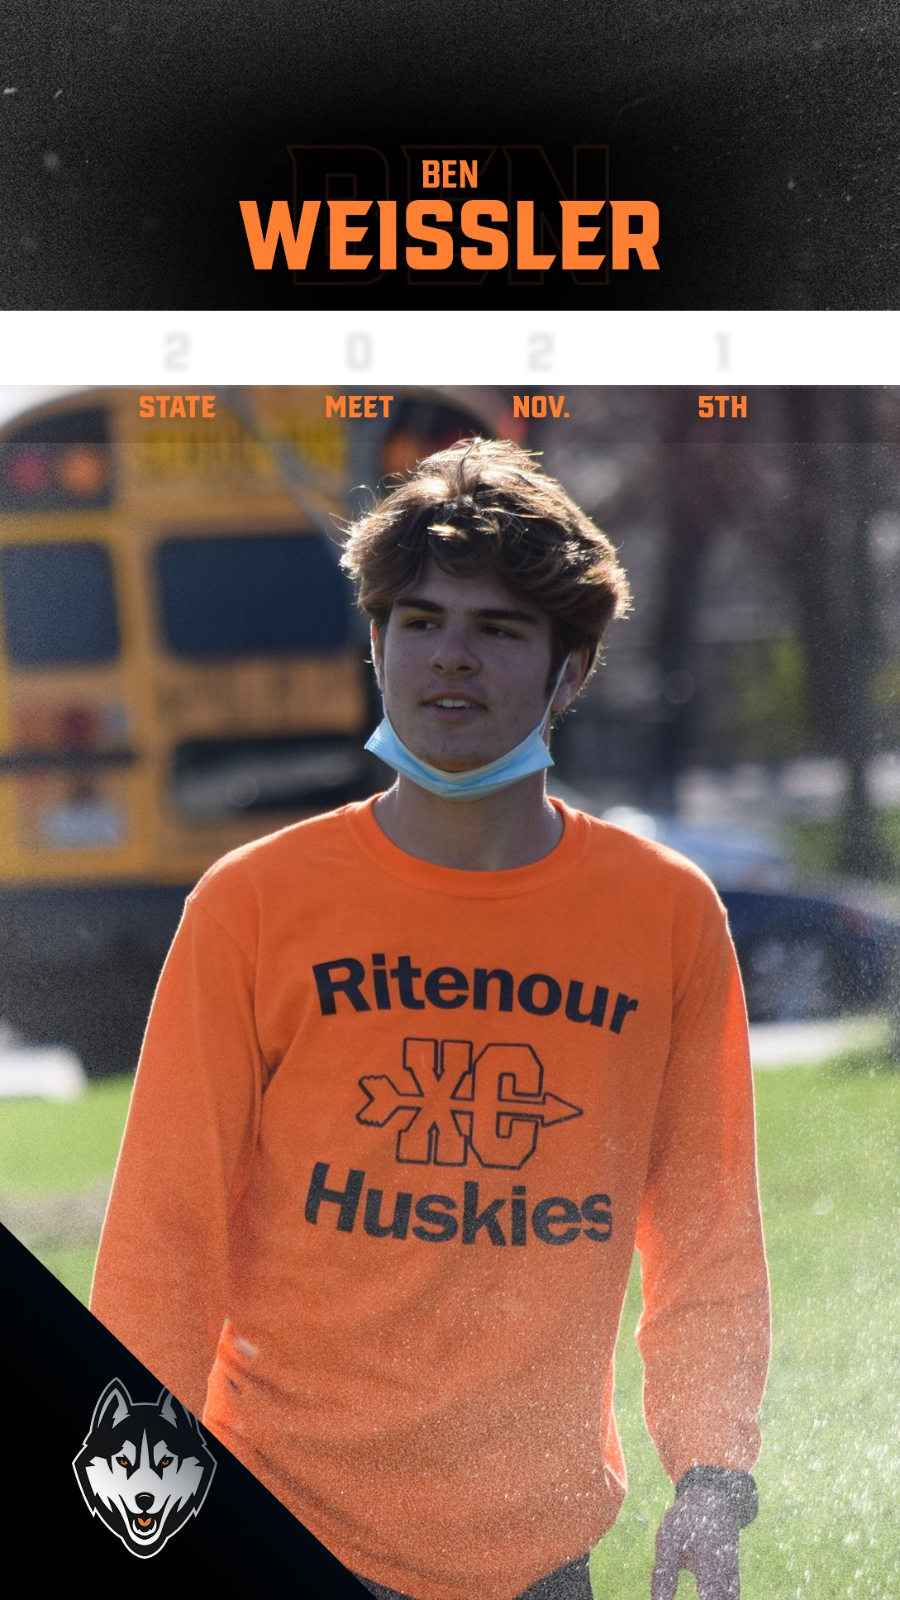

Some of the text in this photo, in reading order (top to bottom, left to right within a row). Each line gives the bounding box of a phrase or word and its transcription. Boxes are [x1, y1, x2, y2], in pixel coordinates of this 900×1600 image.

[312, 953, 639, 1035] Ritenour
[396, 1037, 544, 1171] XC
[304, 1162, 613, 1247] Huskies
